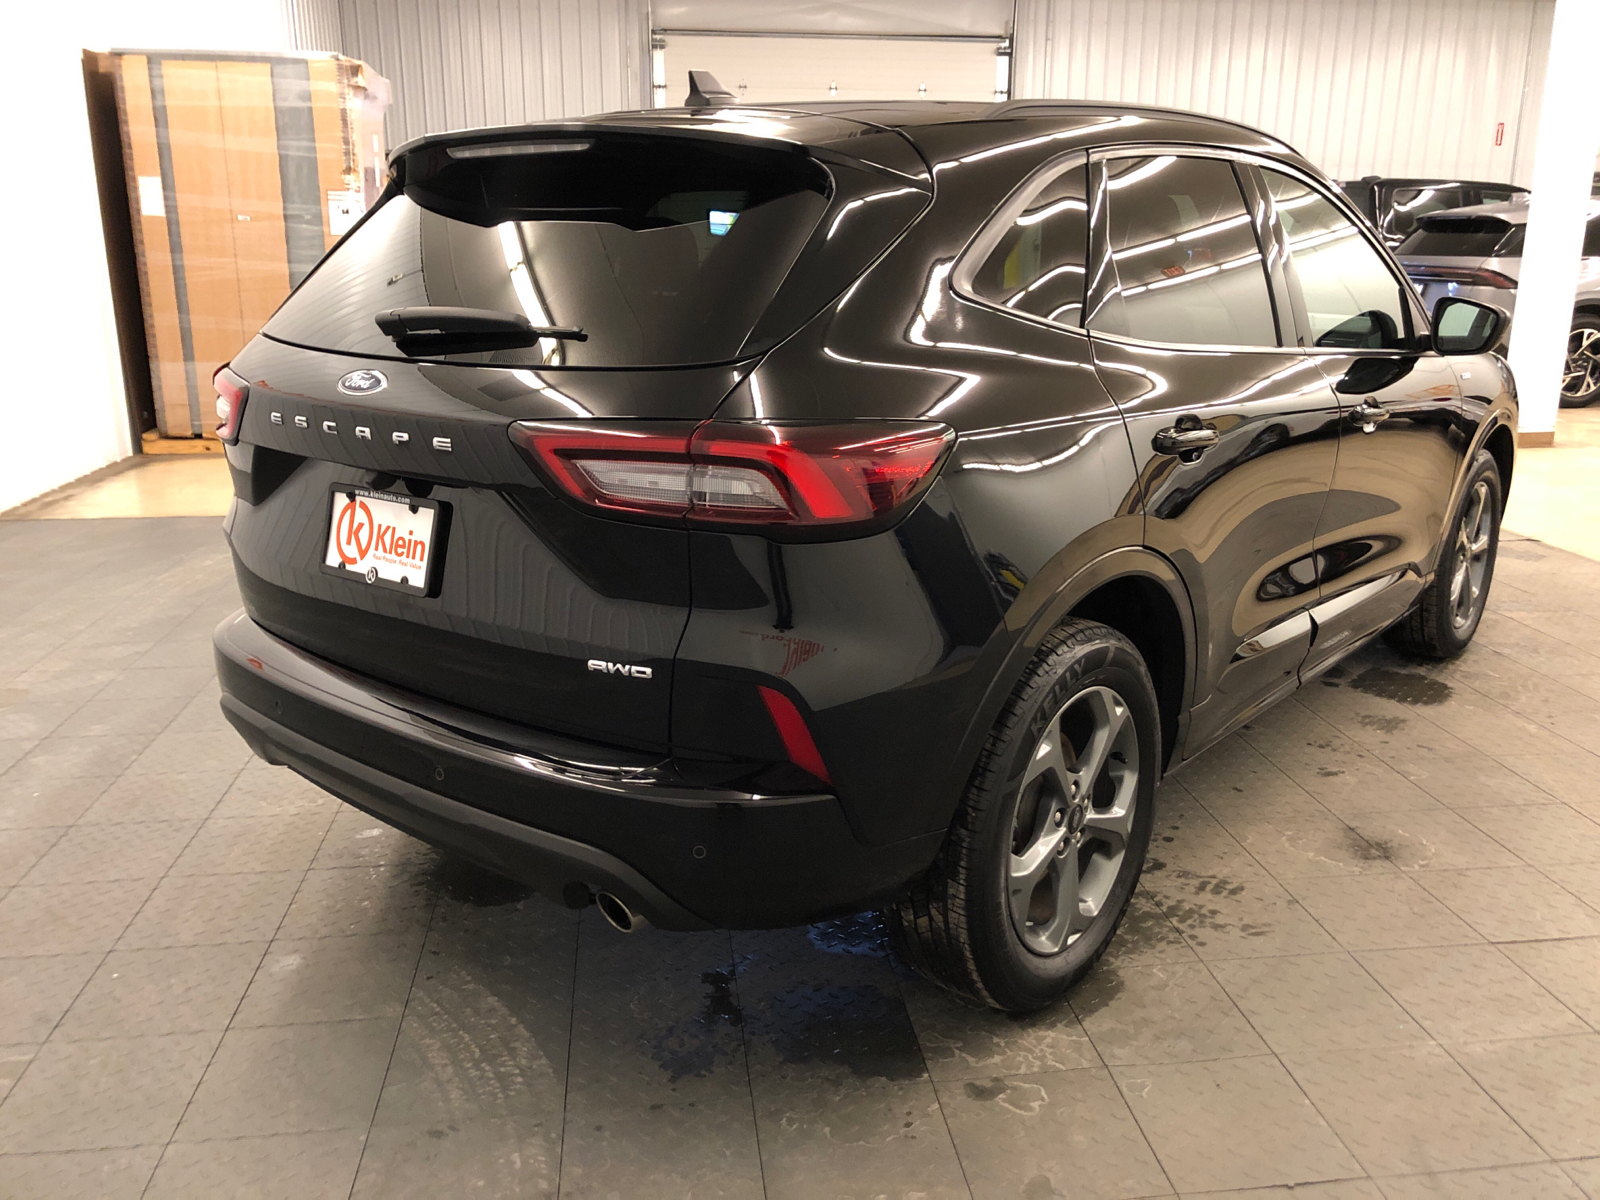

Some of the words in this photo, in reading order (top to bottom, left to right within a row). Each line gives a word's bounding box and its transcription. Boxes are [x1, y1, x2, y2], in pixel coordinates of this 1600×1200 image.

[345, 372, 376, 389] Ford
[270, 411, 452, 452] ESCAPE
[354, 489, 411, 504] www.kleinauto.com
[374, 523, 426, 562] Klein
[588, 659, 653, 679] AWD
[1030, 658, 1085, 738] KELLY
